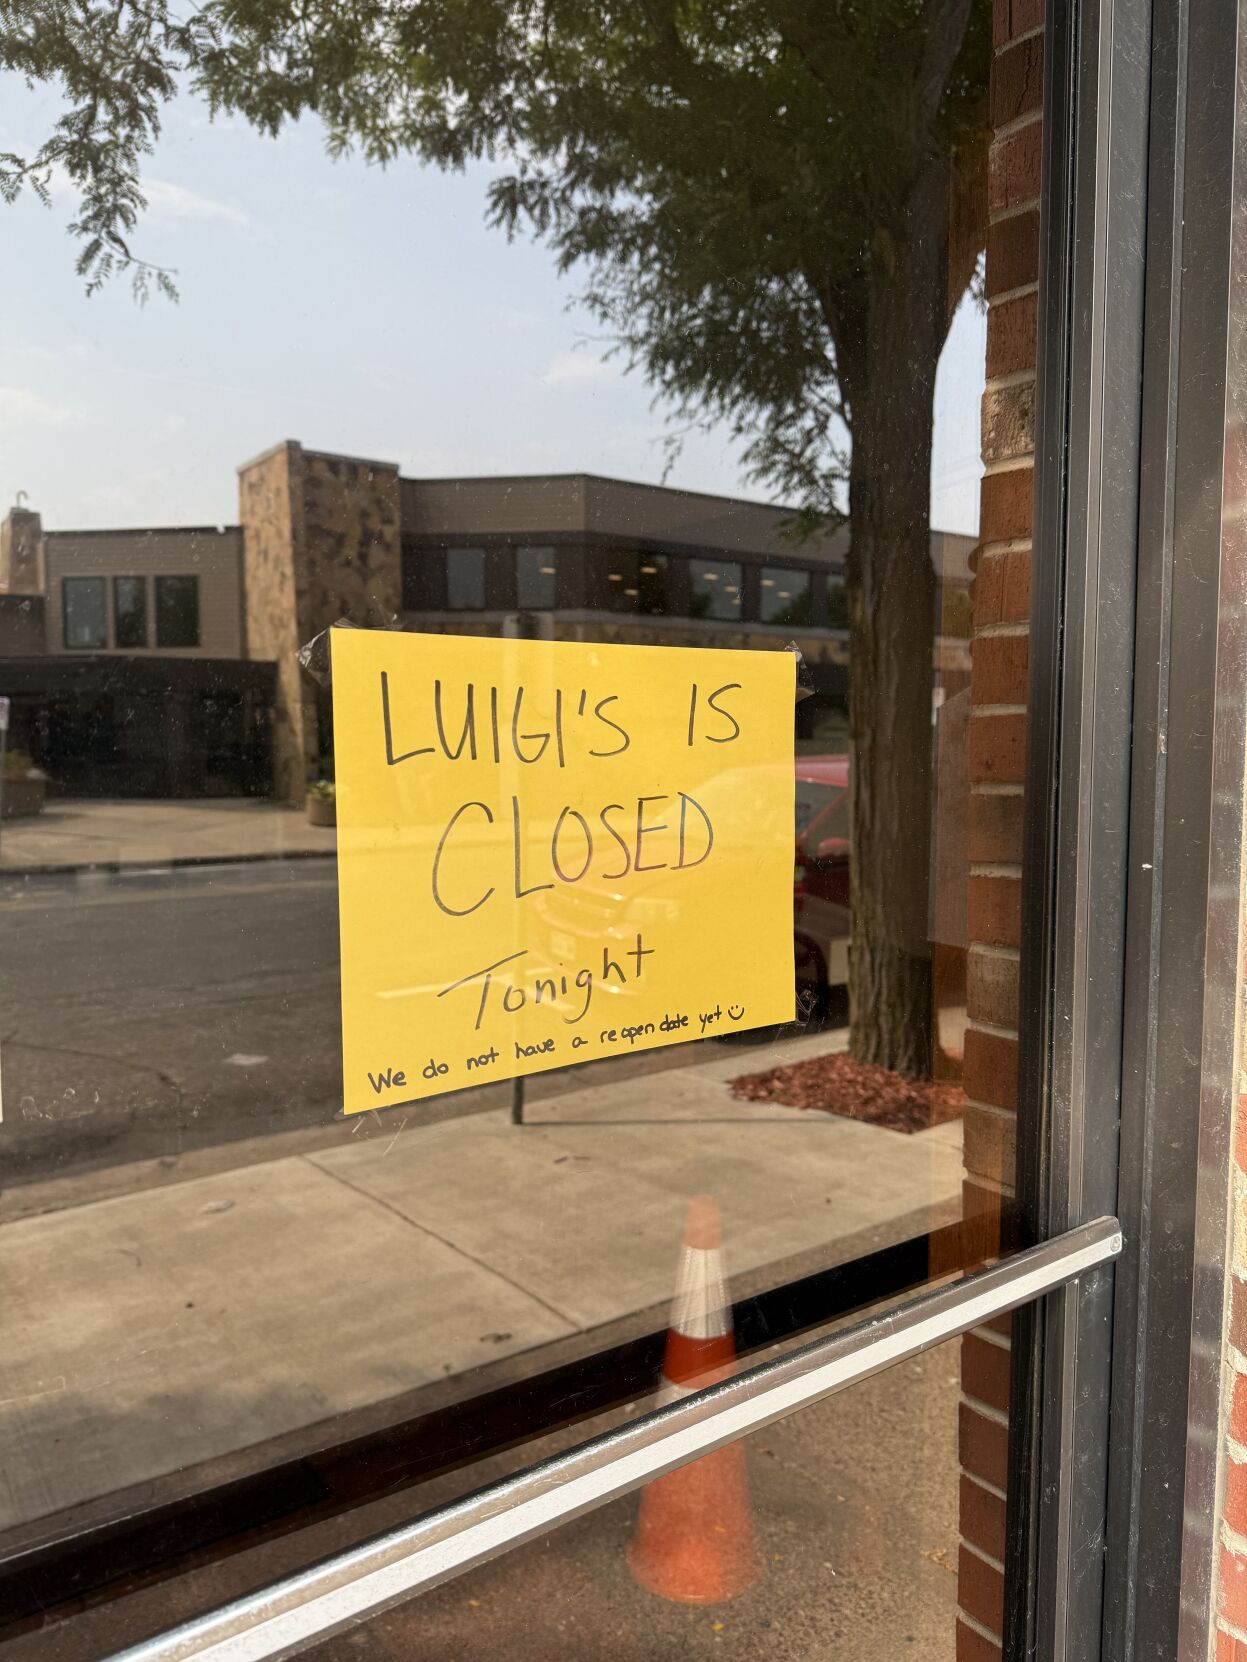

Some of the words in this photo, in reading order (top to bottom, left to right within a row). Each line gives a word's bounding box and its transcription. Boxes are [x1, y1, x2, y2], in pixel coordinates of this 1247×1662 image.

[380, 670, 632, 769] LUIGI'S
[687, 683, 744, 747] IS
[431, 791, 714, 917] CLOSED
[436, 932, 655, 1031] Tonight
[366, 1067, 408, 1095] We
[421, 1058, 450, 1080] do
[465, 1046, 500, 1071] not
[514, 1038, 556, 1060] have
[571, 1036, 589, 1049] a
[658, 1013, 689, 1033] date
[698, 1004, 723, 1034] yet
